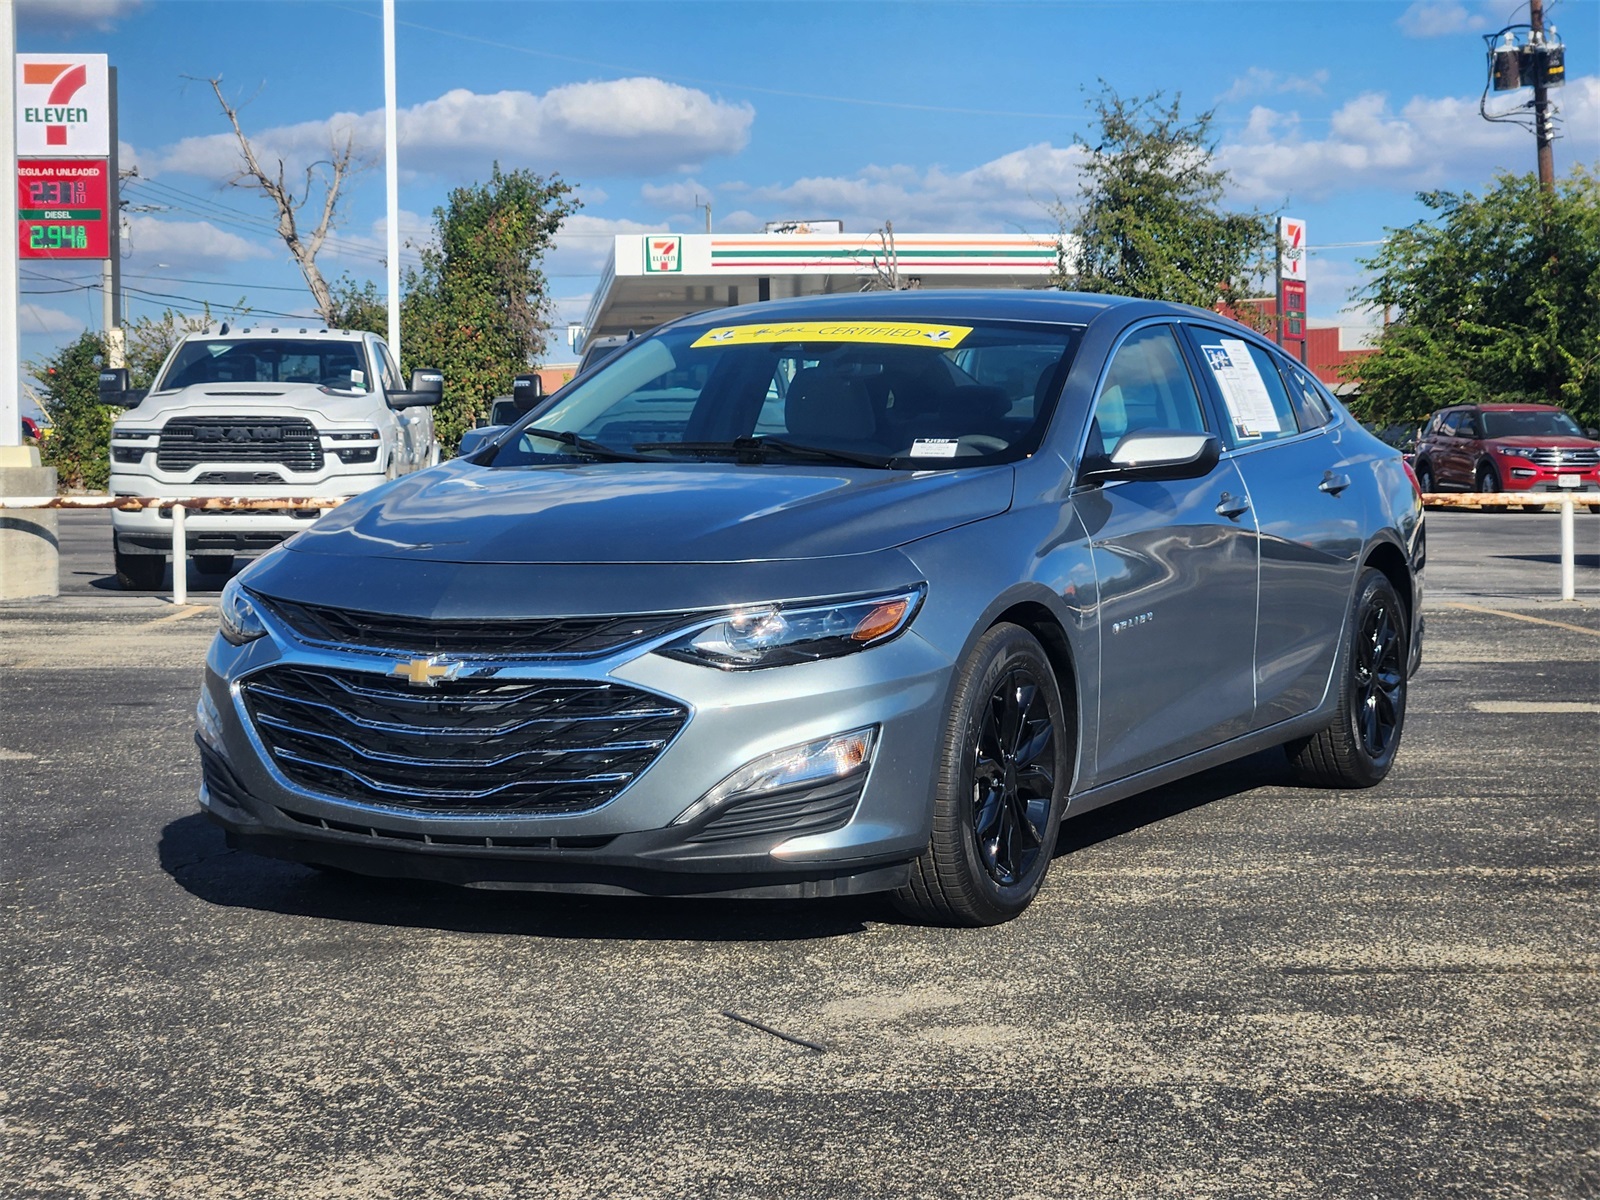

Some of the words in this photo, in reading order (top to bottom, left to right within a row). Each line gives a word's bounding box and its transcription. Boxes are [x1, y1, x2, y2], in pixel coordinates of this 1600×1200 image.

[24, 63, 87, 145] 7
[56, 168, 100, 176] UNLEADED
[44, 211, 72, 219] DIESEL
[1288, 224, 1301, 272] 7
[654, 242, 674, 269] 7
[818, 326, 921, 338] CERTIFIED
[194, 426, 282, 440] RAM
